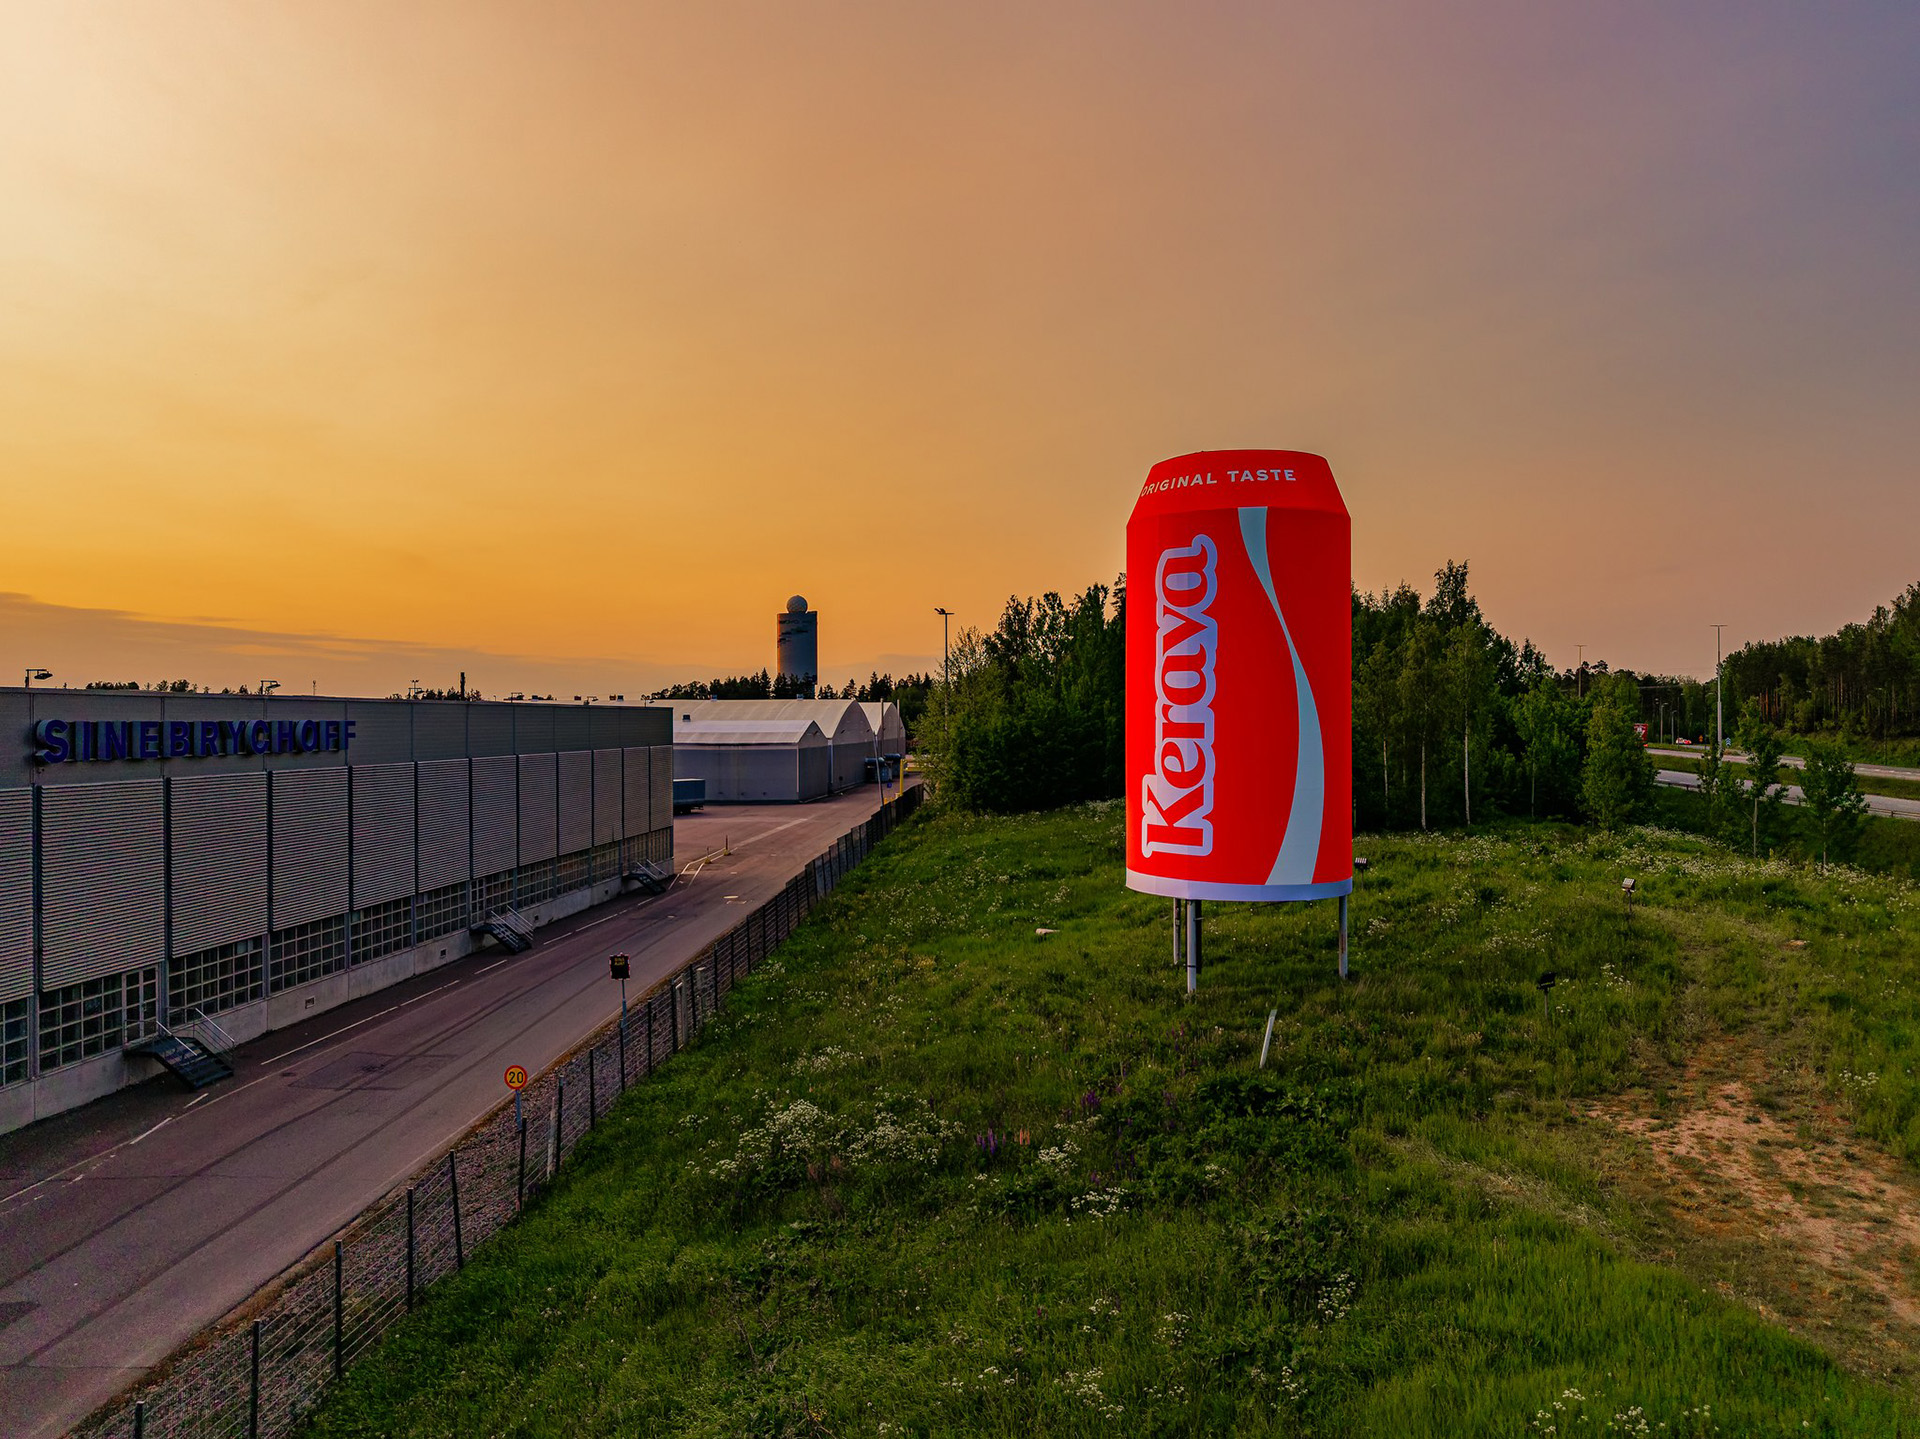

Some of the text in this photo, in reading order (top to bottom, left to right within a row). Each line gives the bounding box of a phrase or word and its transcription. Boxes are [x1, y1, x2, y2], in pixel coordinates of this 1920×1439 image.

[1227, 469, 1297, 482] TASTE
[1142, 534, 1217, 858] Kerava
[39, 719, 356, 763] SINEBRYCHOFF
[508, 1071, 524, 1084] 20
